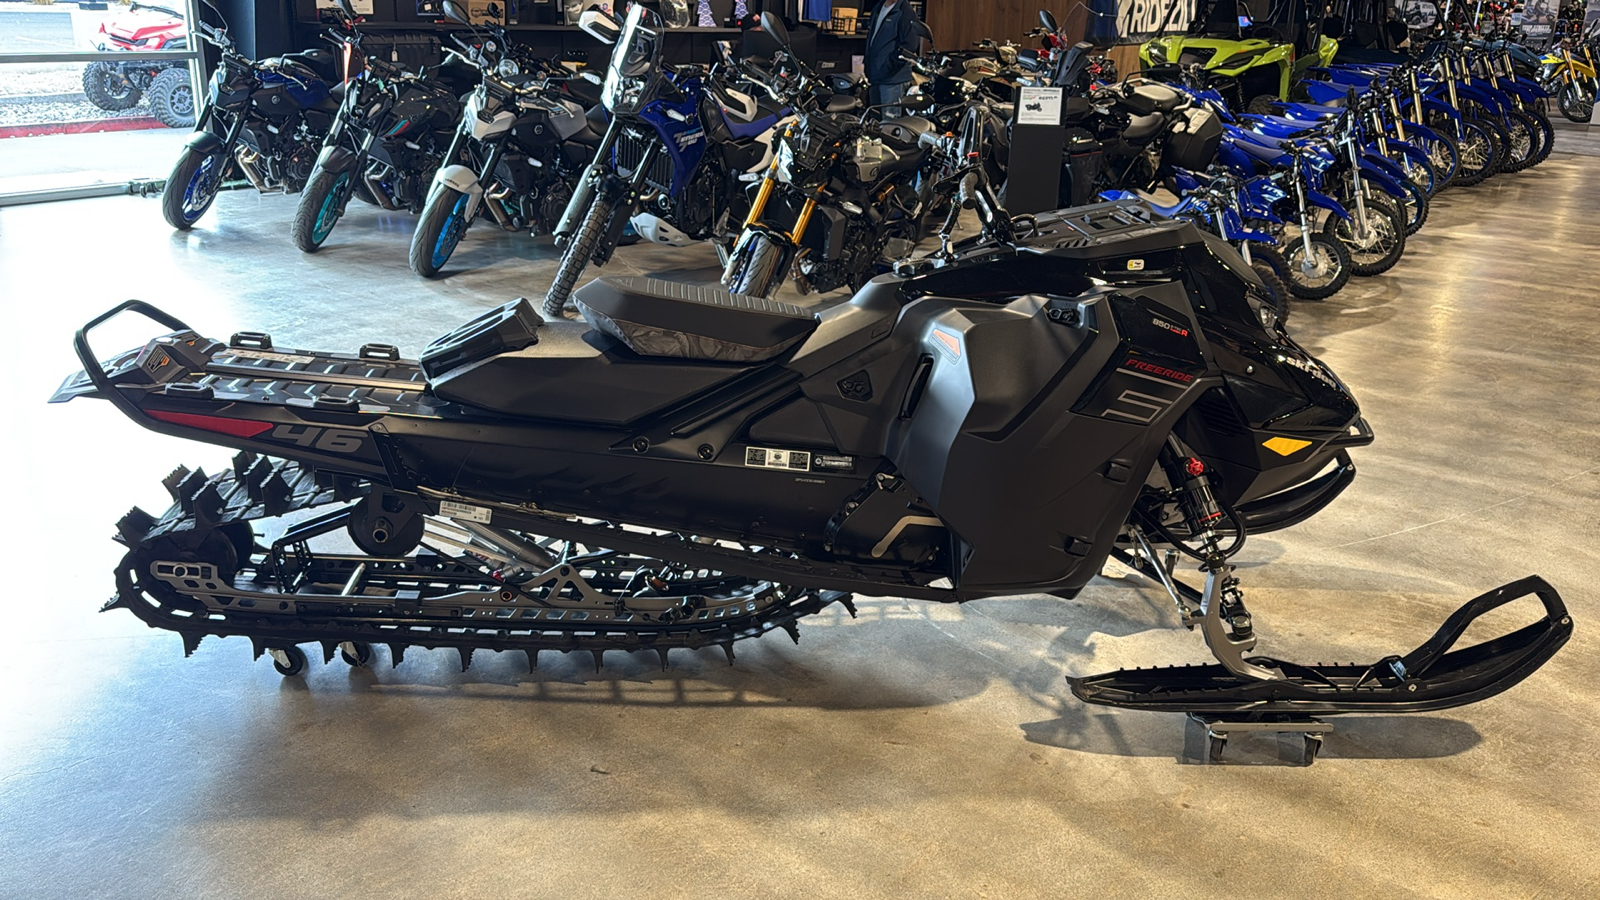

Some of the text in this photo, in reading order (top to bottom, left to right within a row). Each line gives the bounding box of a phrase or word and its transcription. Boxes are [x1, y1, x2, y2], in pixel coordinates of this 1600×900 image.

[1152, 317, 1171, 330] 850
[1125, 358, 1194, 382] FREERIDE
[272, 424, 369, 453] 46
